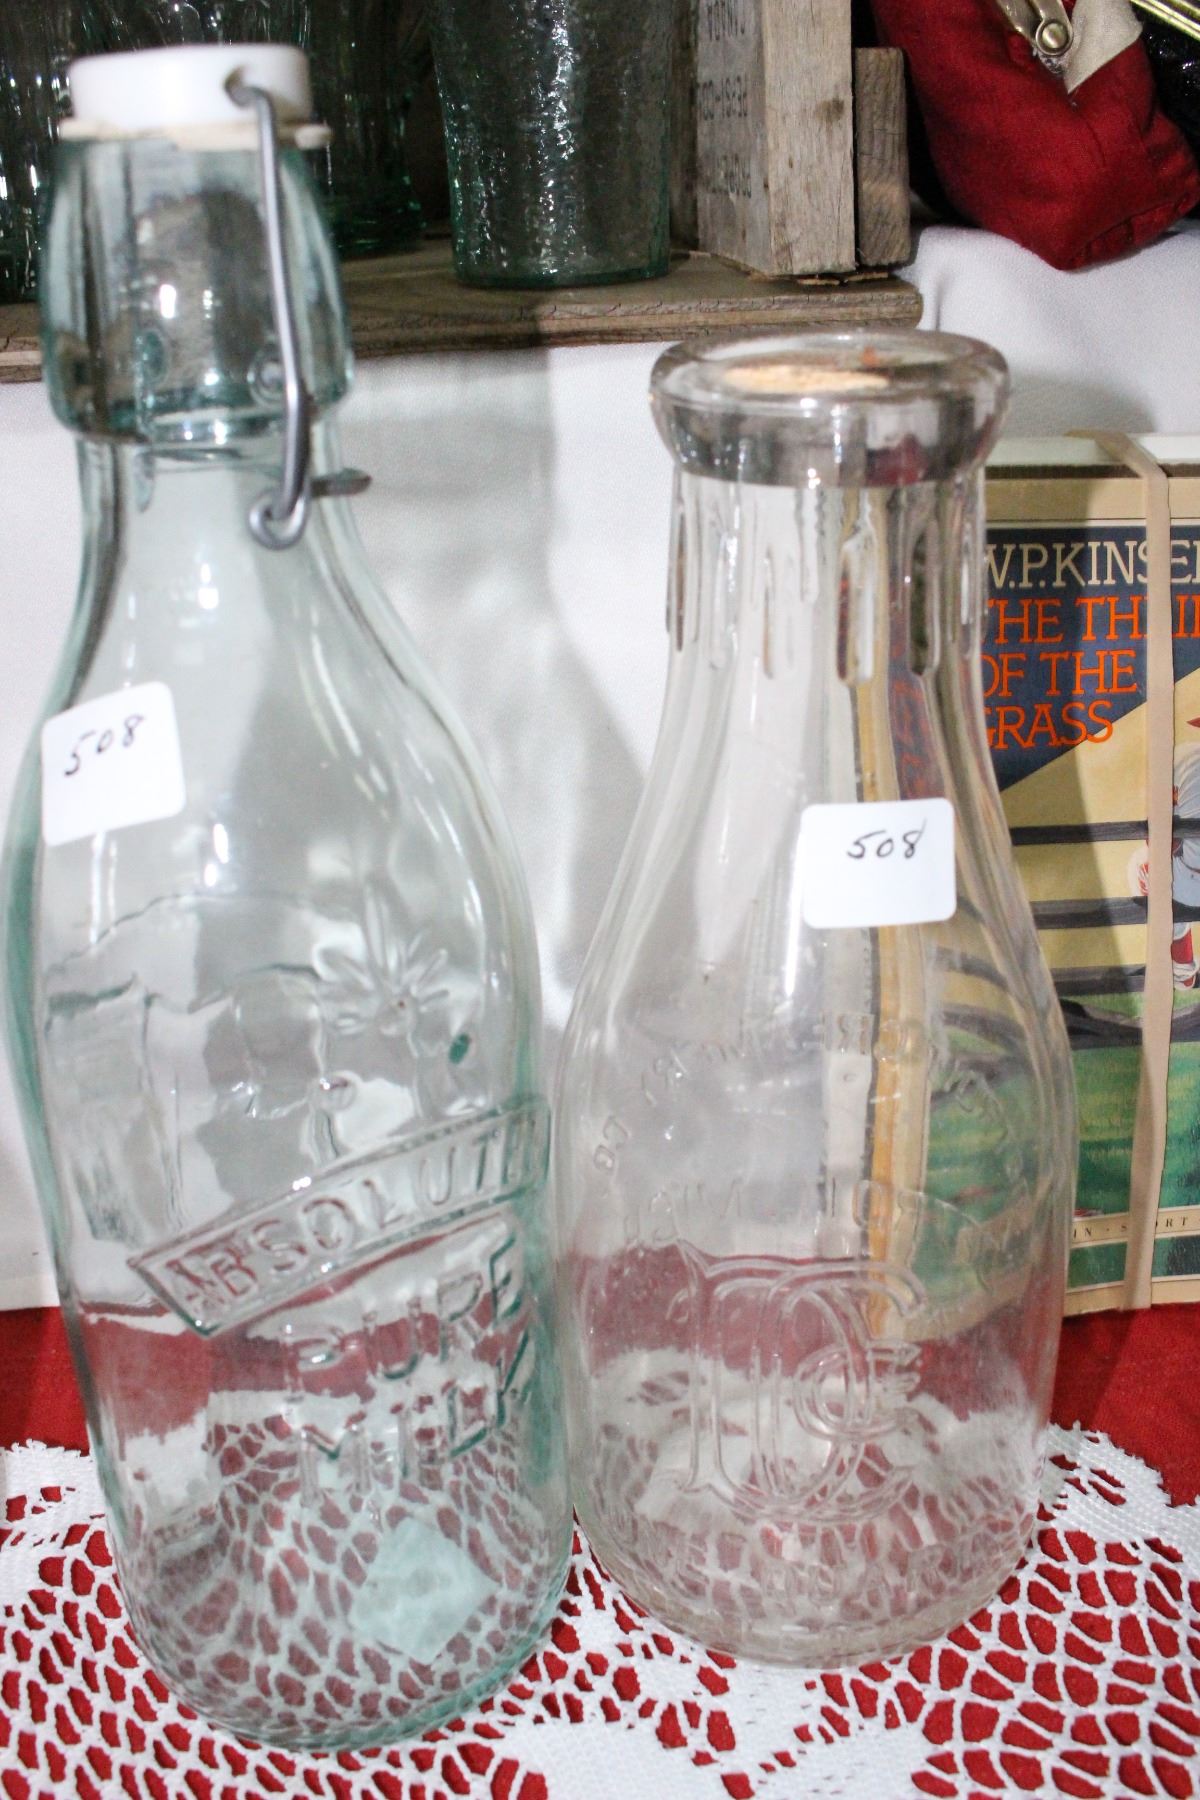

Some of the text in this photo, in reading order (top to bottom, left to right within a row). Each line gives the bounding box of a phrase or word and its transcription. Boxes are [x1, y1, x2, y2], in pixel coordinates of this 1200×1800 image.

[987, 593, 1200, 644] HE THI
[1039, 649, 1137, 696] THE
[64, 714, 145, 777] 508
[847, 817, 928, 860] 508
